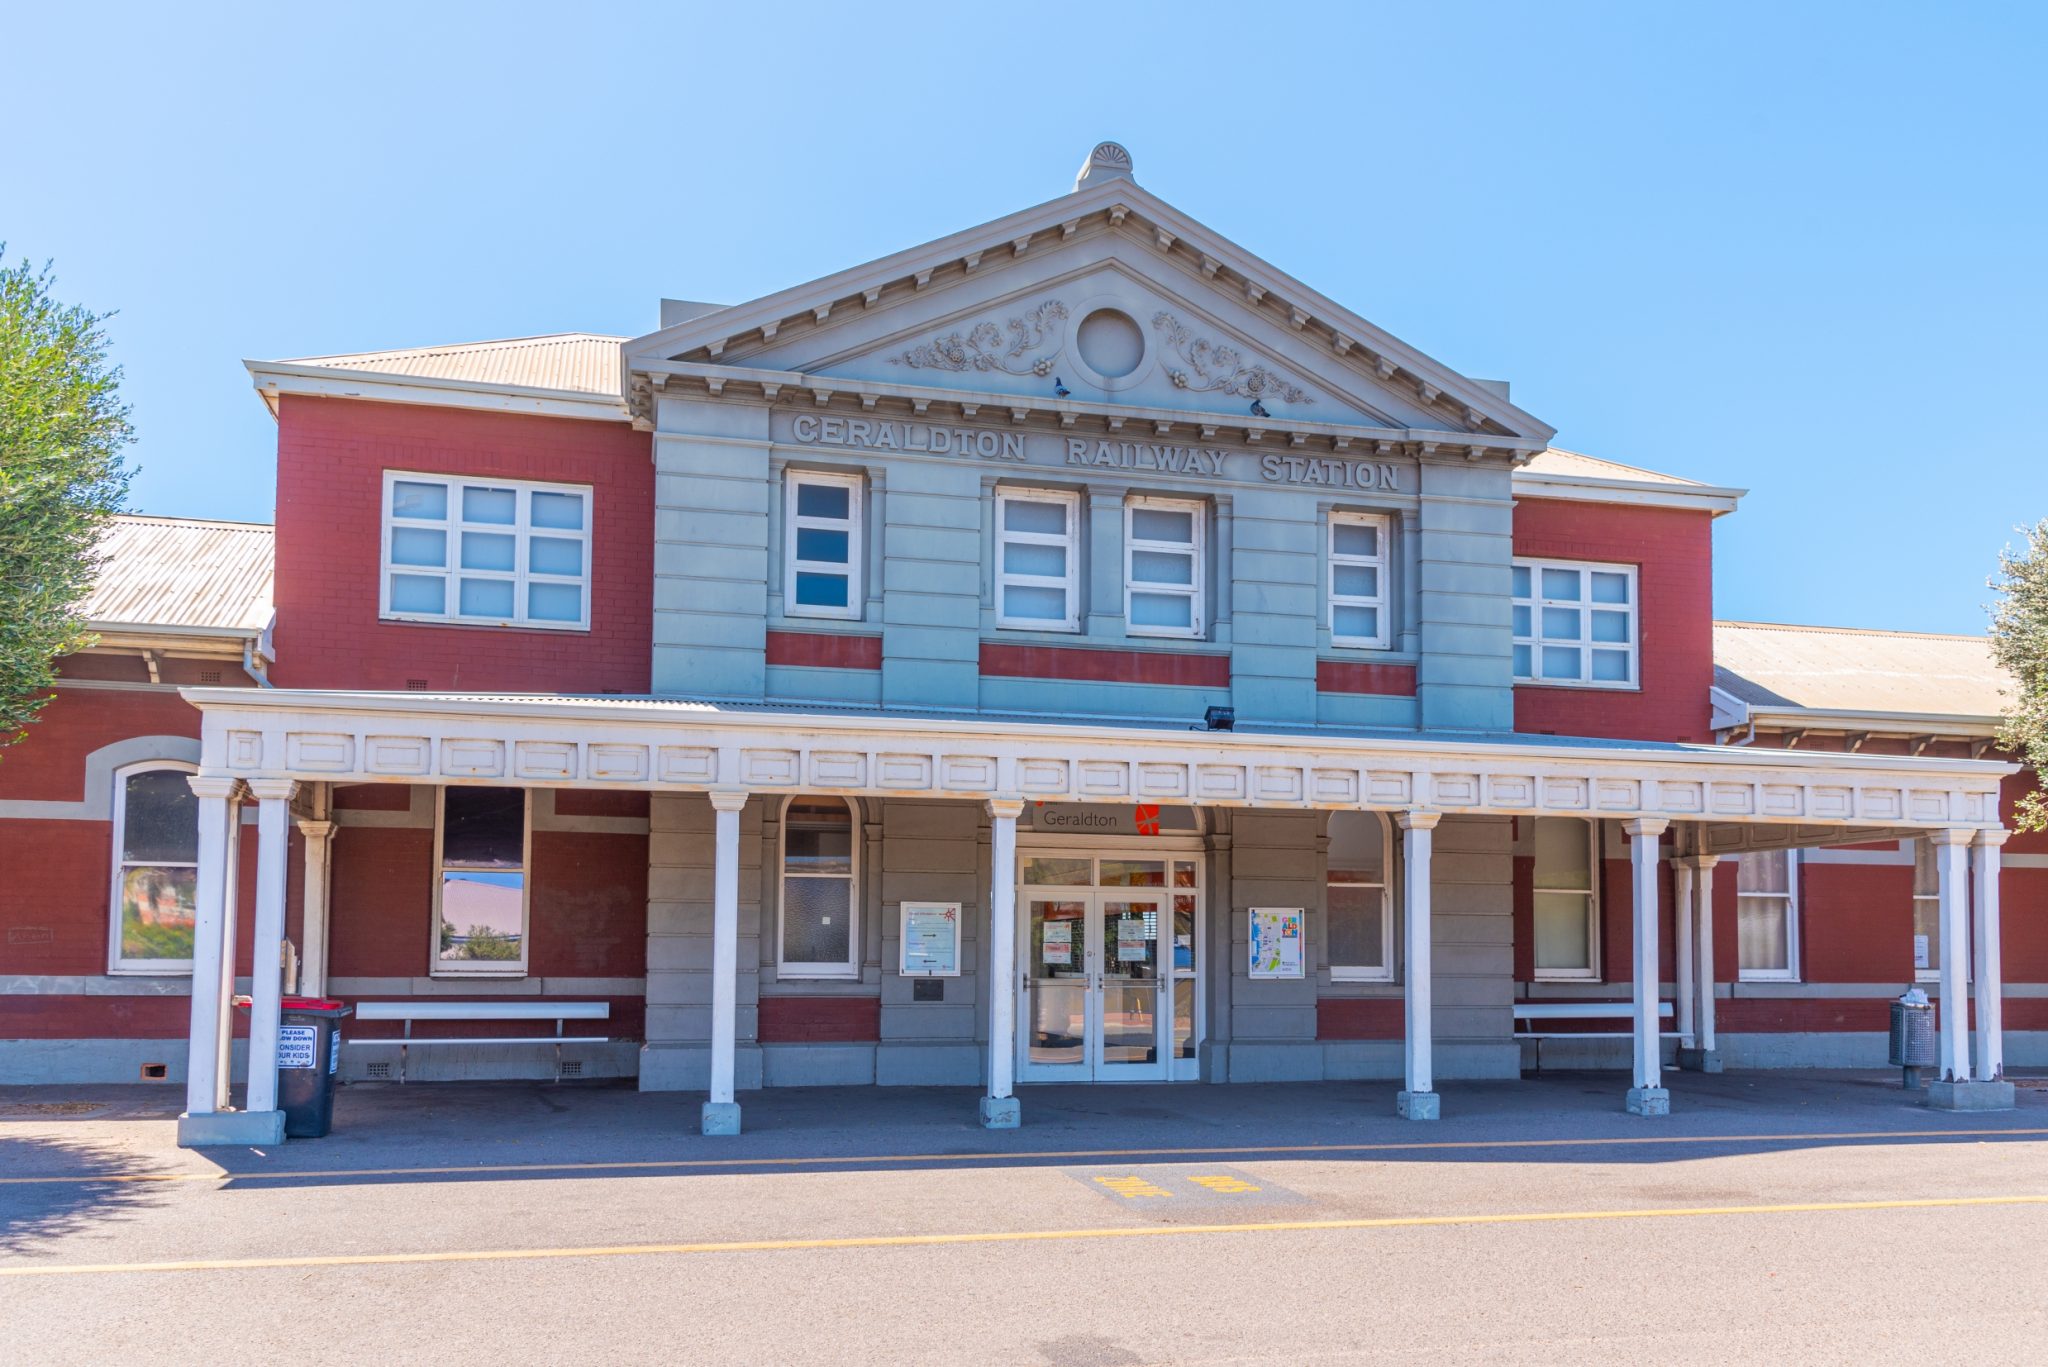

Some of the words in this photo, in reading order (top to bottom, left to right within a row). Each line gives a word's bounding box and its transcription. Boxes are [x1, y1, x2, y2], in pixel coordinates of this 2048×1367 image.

[792, 414, 1027, 461] GERALDTON
[1065, 437, 1229, 476] RAILWAY
[1261, 454, 1401, 490] STATION
[1043, 810, 1118, 827] Geraldton
